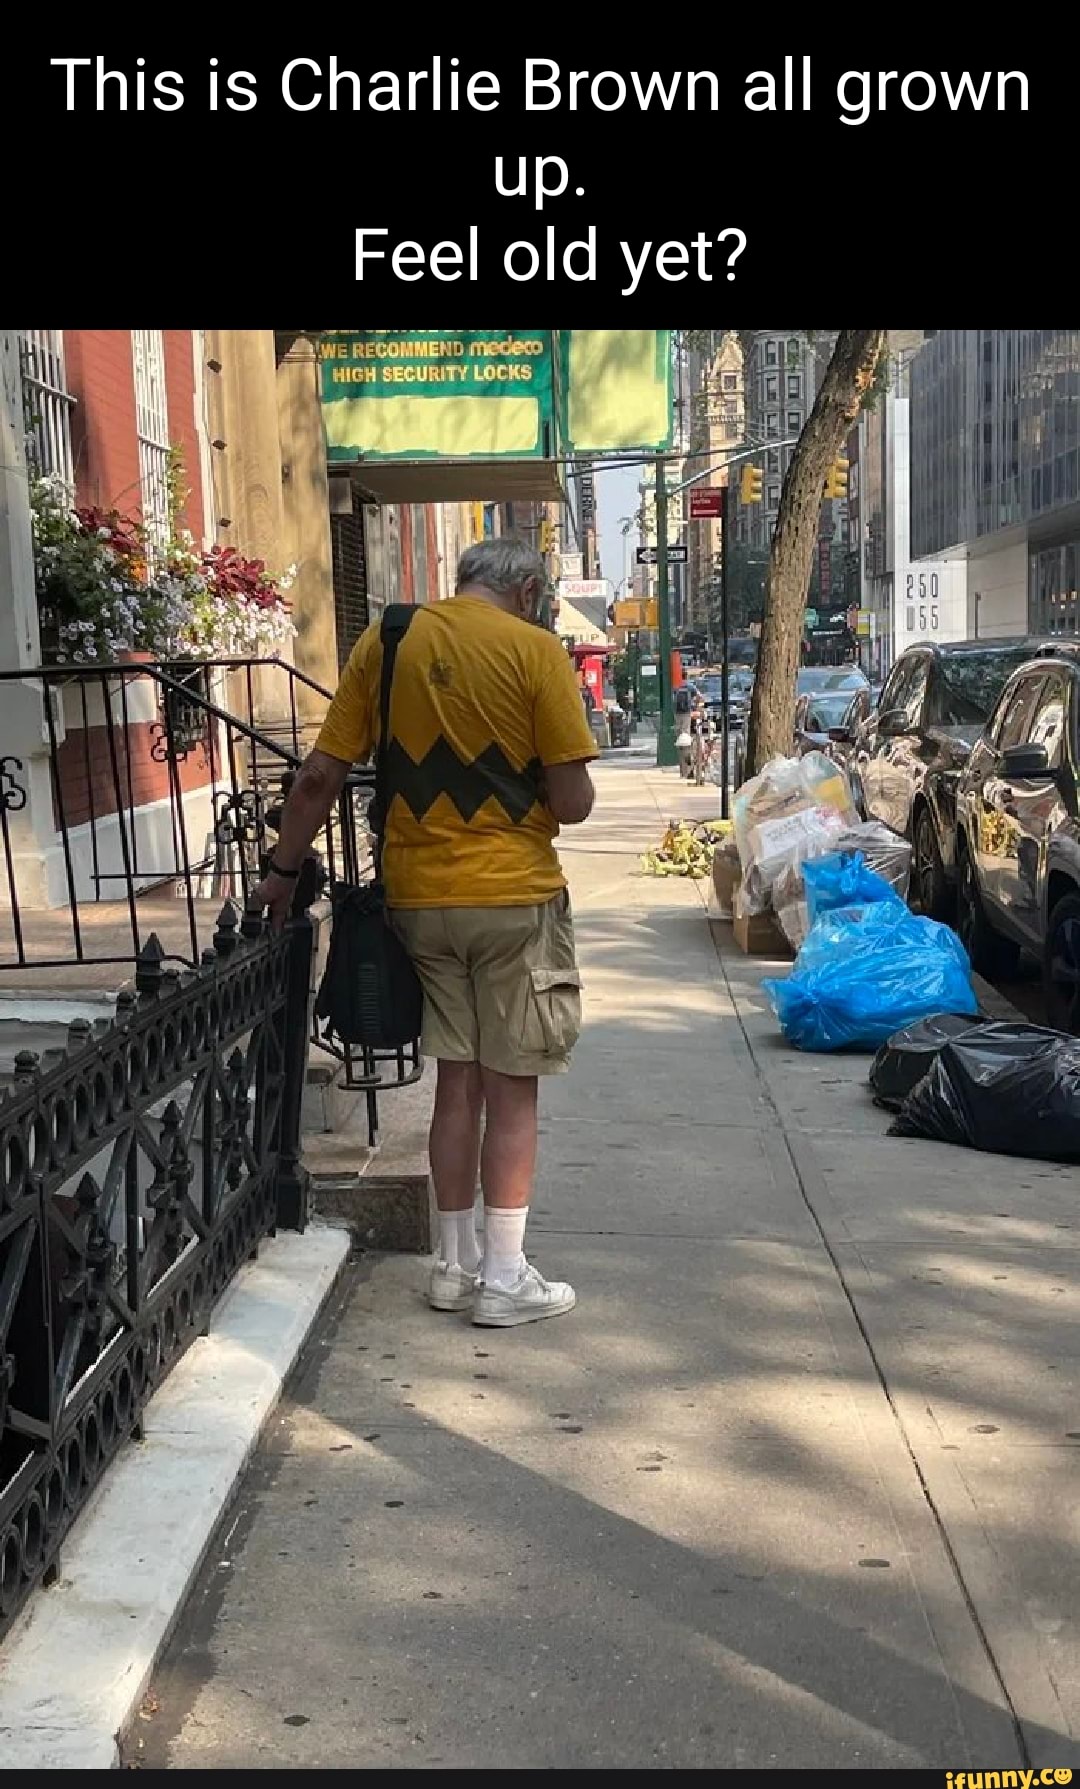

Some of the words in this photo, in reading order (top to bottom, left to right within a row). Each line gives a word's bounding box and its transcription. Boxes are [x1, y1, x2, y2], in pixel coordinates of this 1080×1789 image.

[321, 343, 348, 359] WE
[352, 341, 464, 359] RECOMMEND
[470, 335, 544, 356] medeco
[332, 366, 377, 383] HIGH
[382, 364, 468, 382] SECURITY
[473, 364, 533, 381] LOCKS
[565, 583, 602, 595] SOUP!
[907, 573, 938, 599] 250
